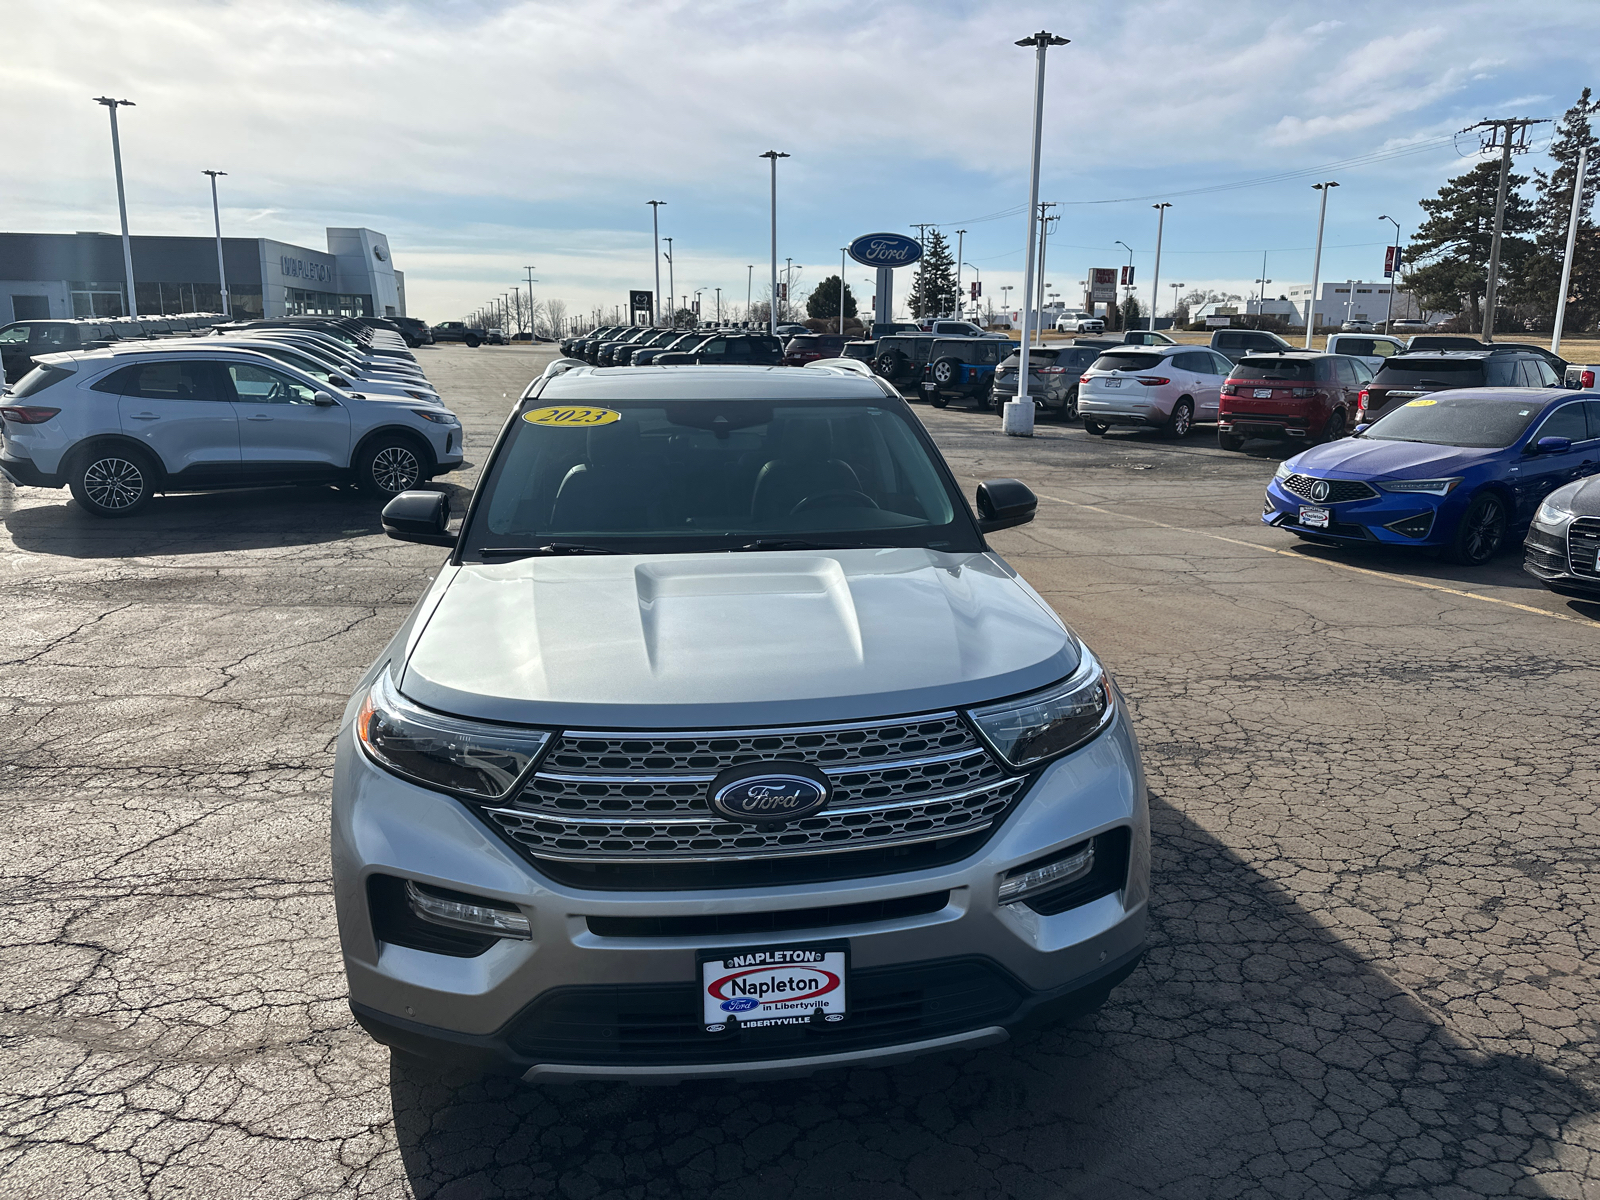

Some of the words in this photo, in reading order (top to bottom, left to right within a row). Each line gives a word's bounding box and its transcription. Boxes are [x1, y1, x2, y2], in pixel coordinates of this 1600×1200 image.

[866, 240, 909, 260] Ford
[281, 255, 332, 282] NAPLETON
[536, 410, 608, 422] 2023
[741, 785, 801, 811] Ford
[733, 950, 816, 968] NAPLETON
[731, 976, 819, 998] Napleton
[728, 1000, 752, 1011] Ford
[774, 1000, 830, 1011] Libertyville
[741, 1016, 811, 1029] LIBERTYVILLE
